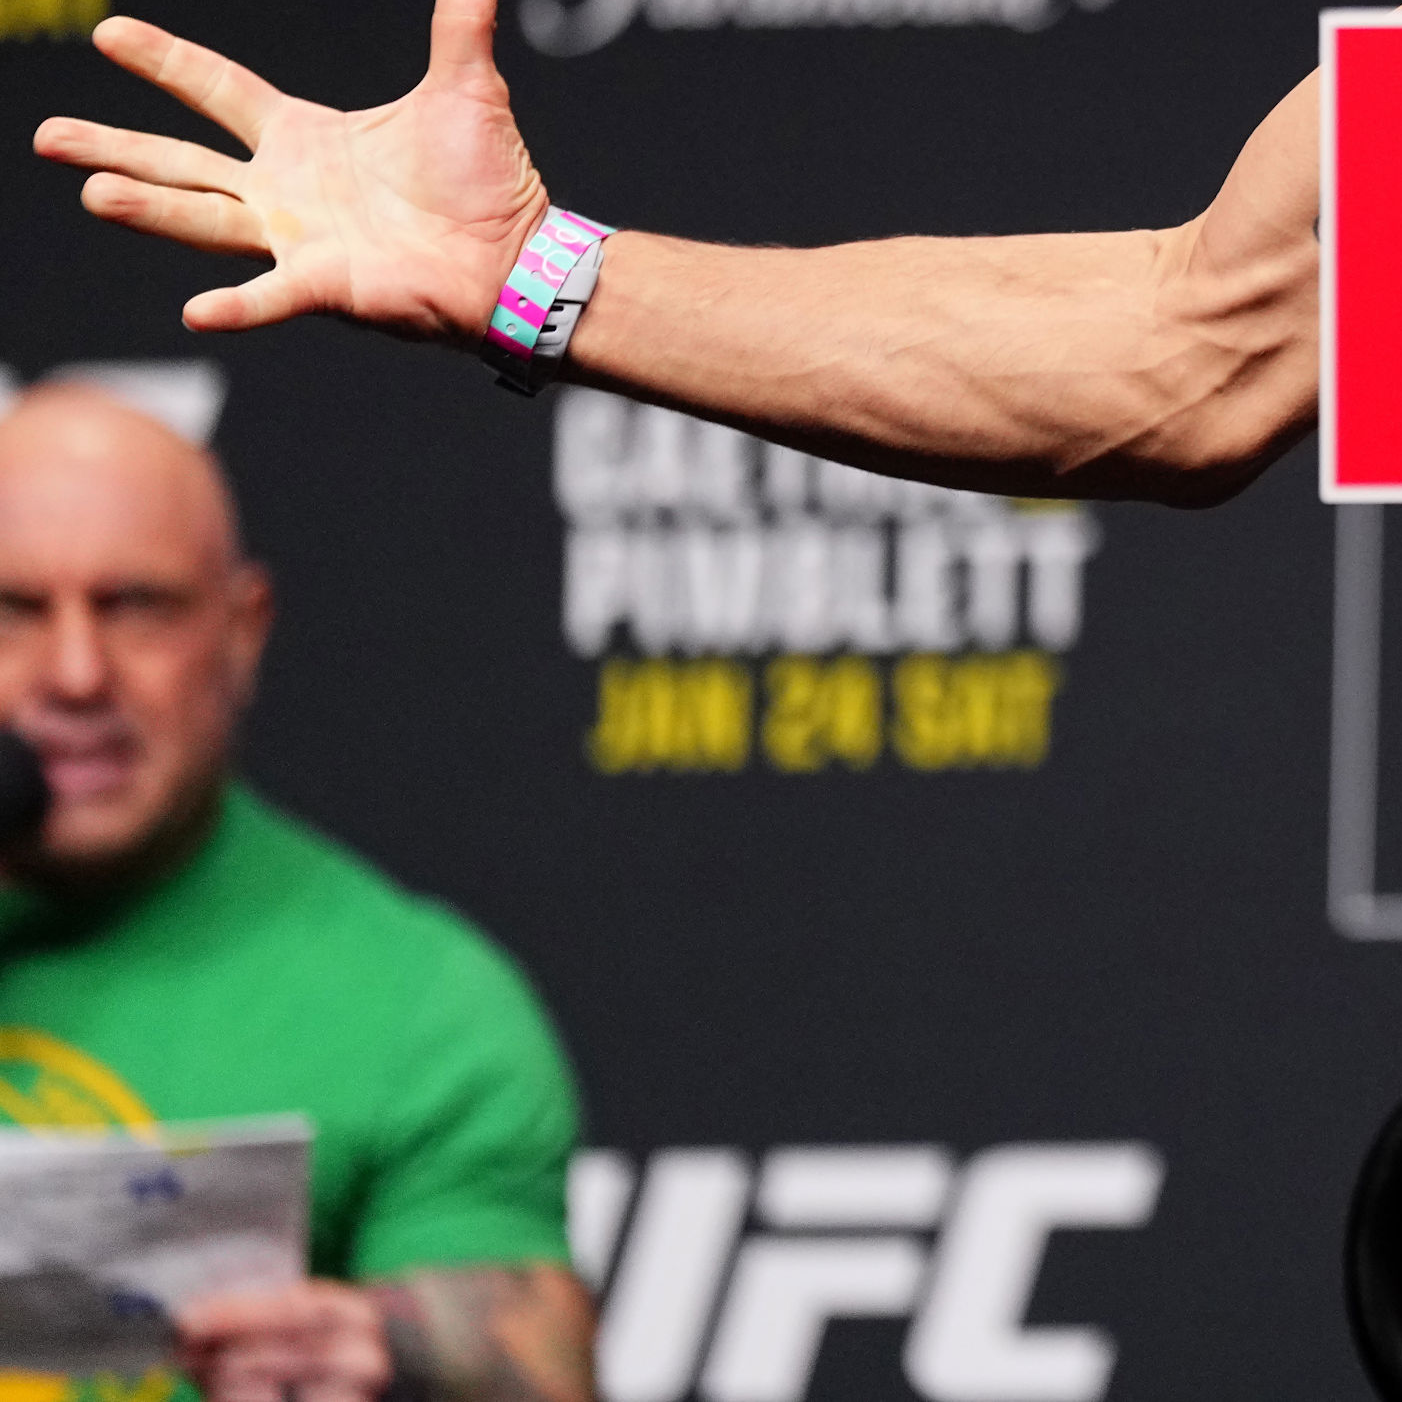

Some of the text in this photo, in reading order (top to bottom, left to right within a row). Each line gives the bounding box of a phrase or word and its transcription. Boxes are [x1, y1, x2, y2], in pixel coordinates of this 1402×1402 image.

[588, 652, 1064, 774] JAN 24 SAT
[567, 1143, 1166, 1402] UFC
